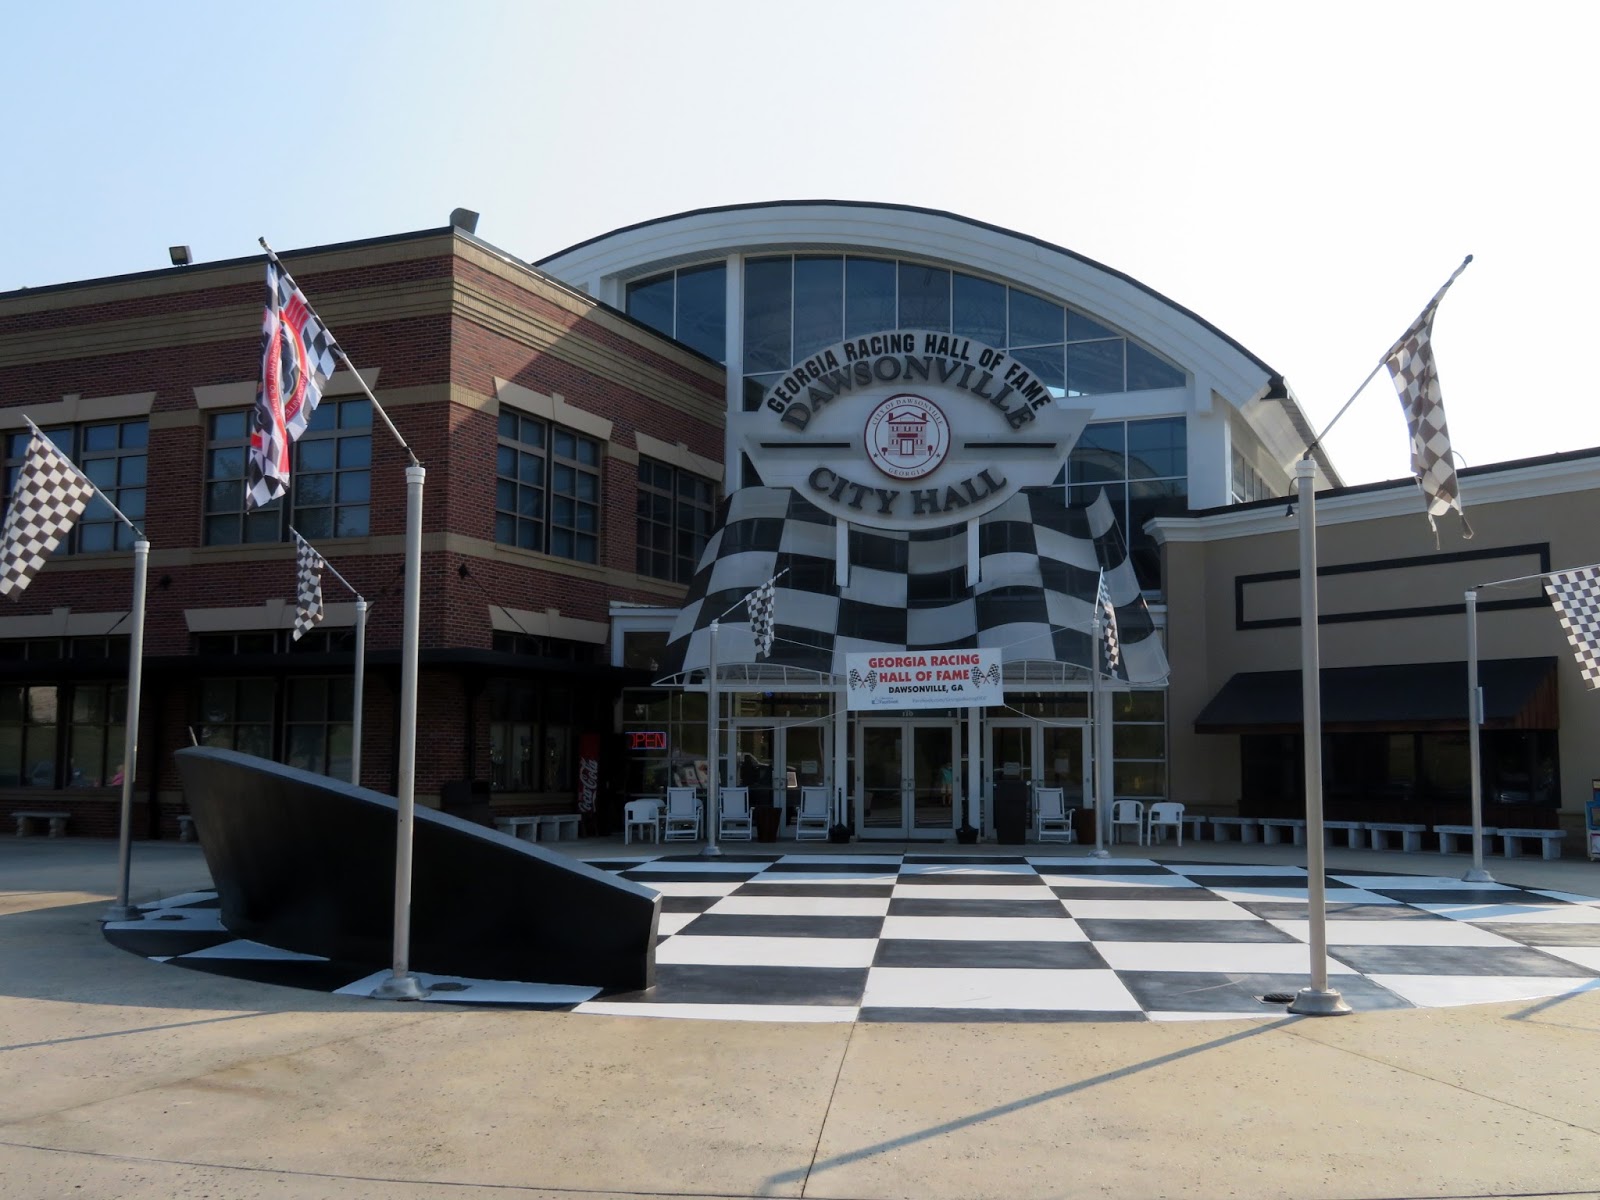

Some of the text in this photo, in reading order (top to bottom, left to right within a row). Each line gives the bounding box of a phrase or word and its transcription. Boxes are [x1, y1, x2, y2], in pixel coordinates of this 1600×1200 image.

[767, 334, 1052, 414] GEORGIA RACING HALL OF FAME
[781, 355, 1036, 431] DAWSONVILLE
[872, 408, 885, 426] CITY
[896, 398, 943, 425] DAWSONVILLE
[888, 467, 926, 477] GEORGIA
[808, 467, 1007, 514] CITY HALL
[868, 654, 980, 669] GEORGIA RACING
[879, 669, 970, 683] HALL OF FAME
[888, 684, 964, 694] DAWSONVILLE, GA
